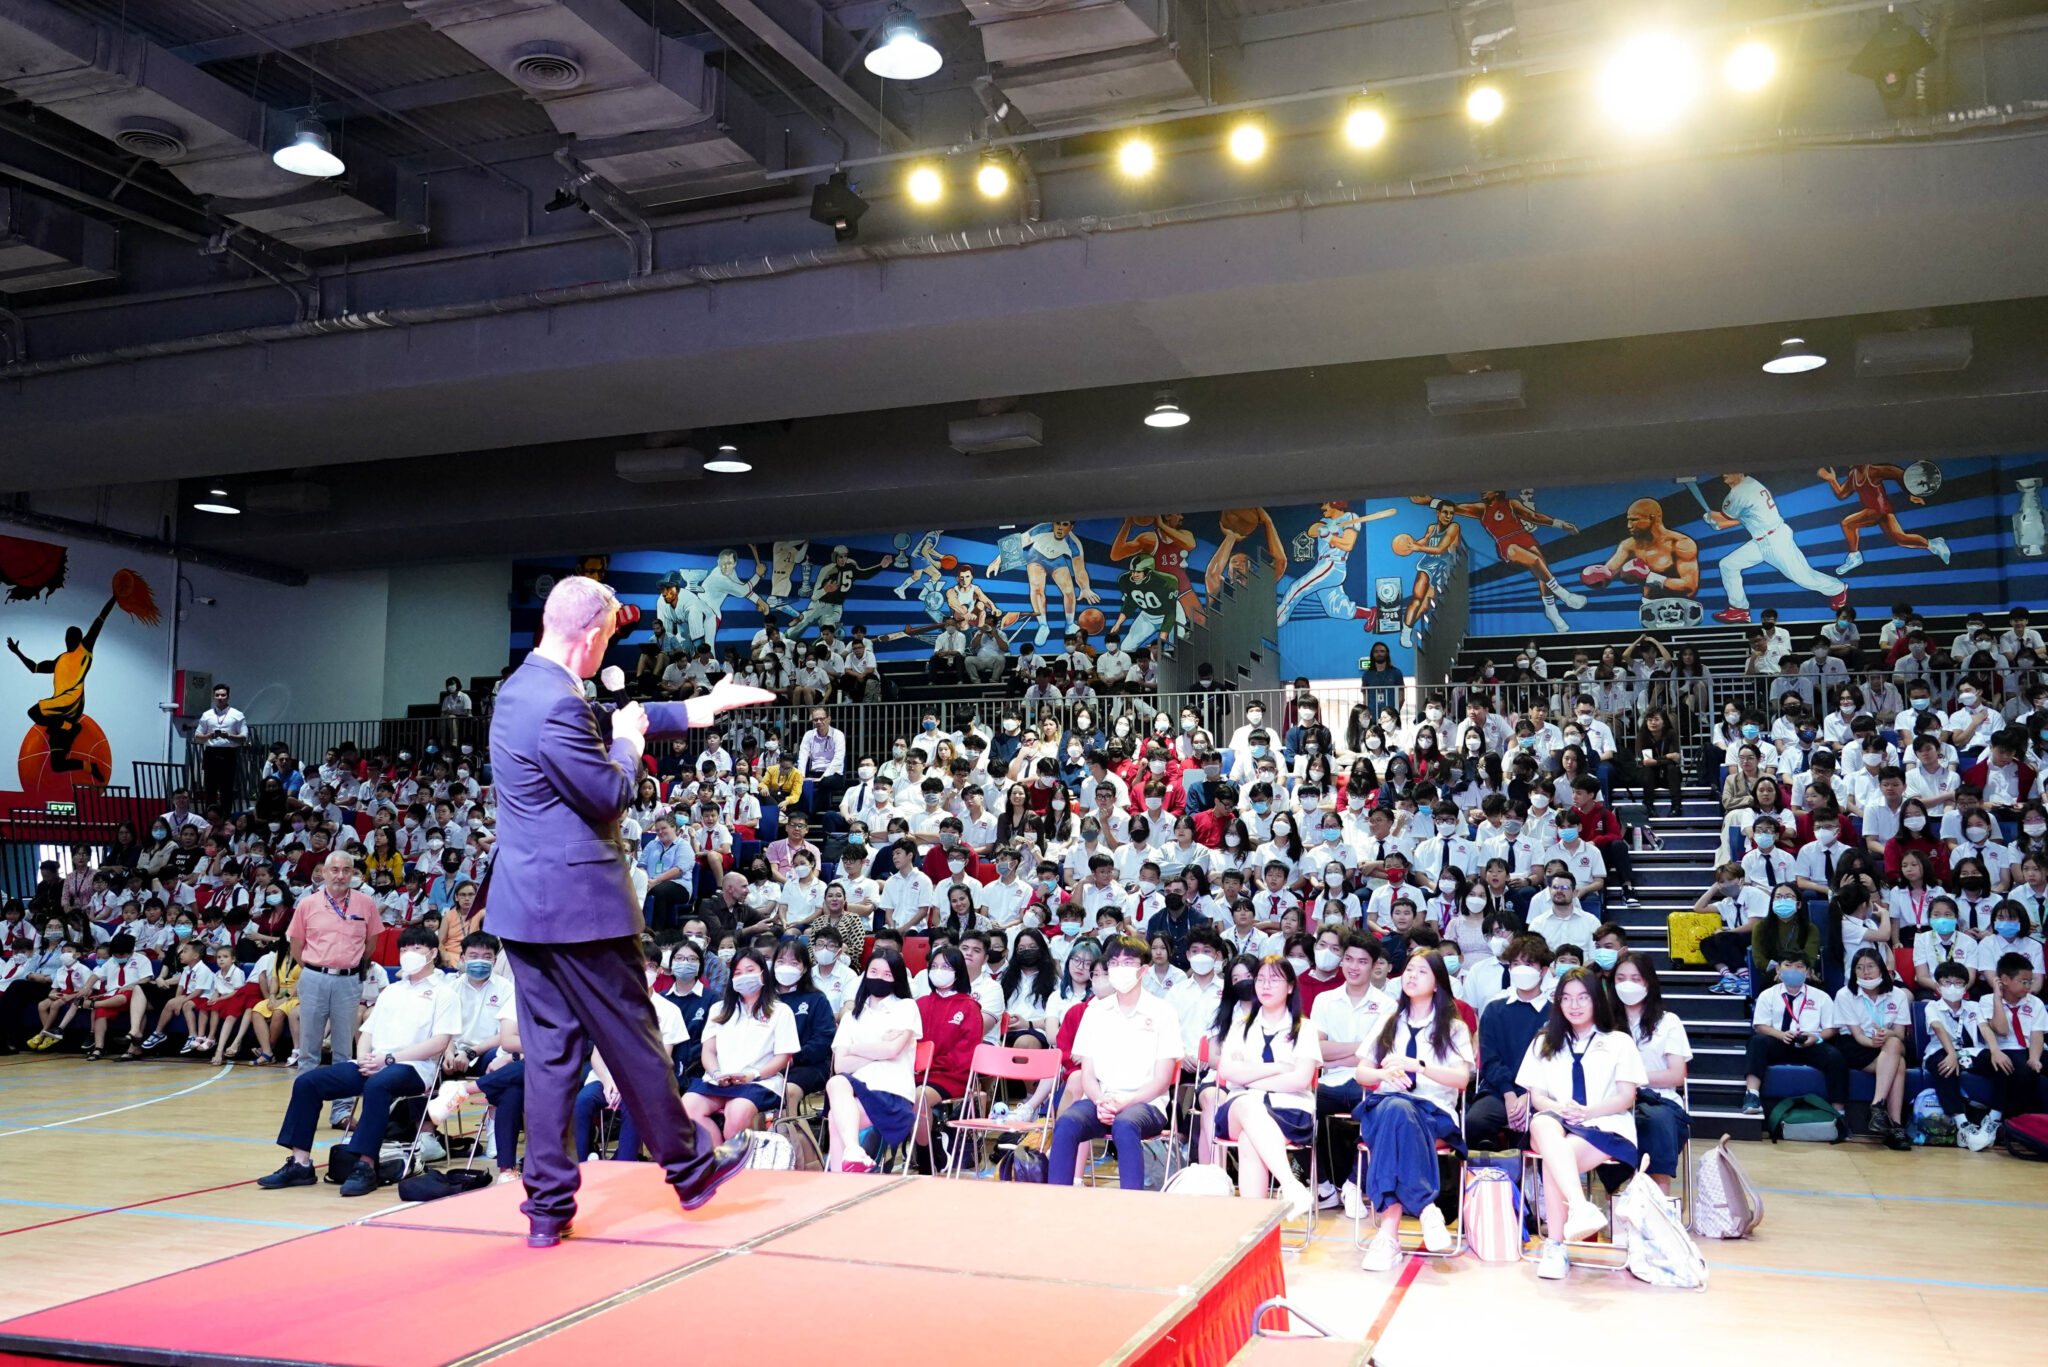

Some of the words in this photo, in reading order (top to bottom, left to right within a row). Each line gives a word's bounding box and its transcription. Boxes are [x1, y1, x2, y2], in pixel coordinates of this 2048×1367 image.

[1760, 489, 1776, 510] 2
[1493, 510, 1505, 521] 6
[1161, 553, 1178, 566] 13
[1131, 589, 1162, 609] 60
